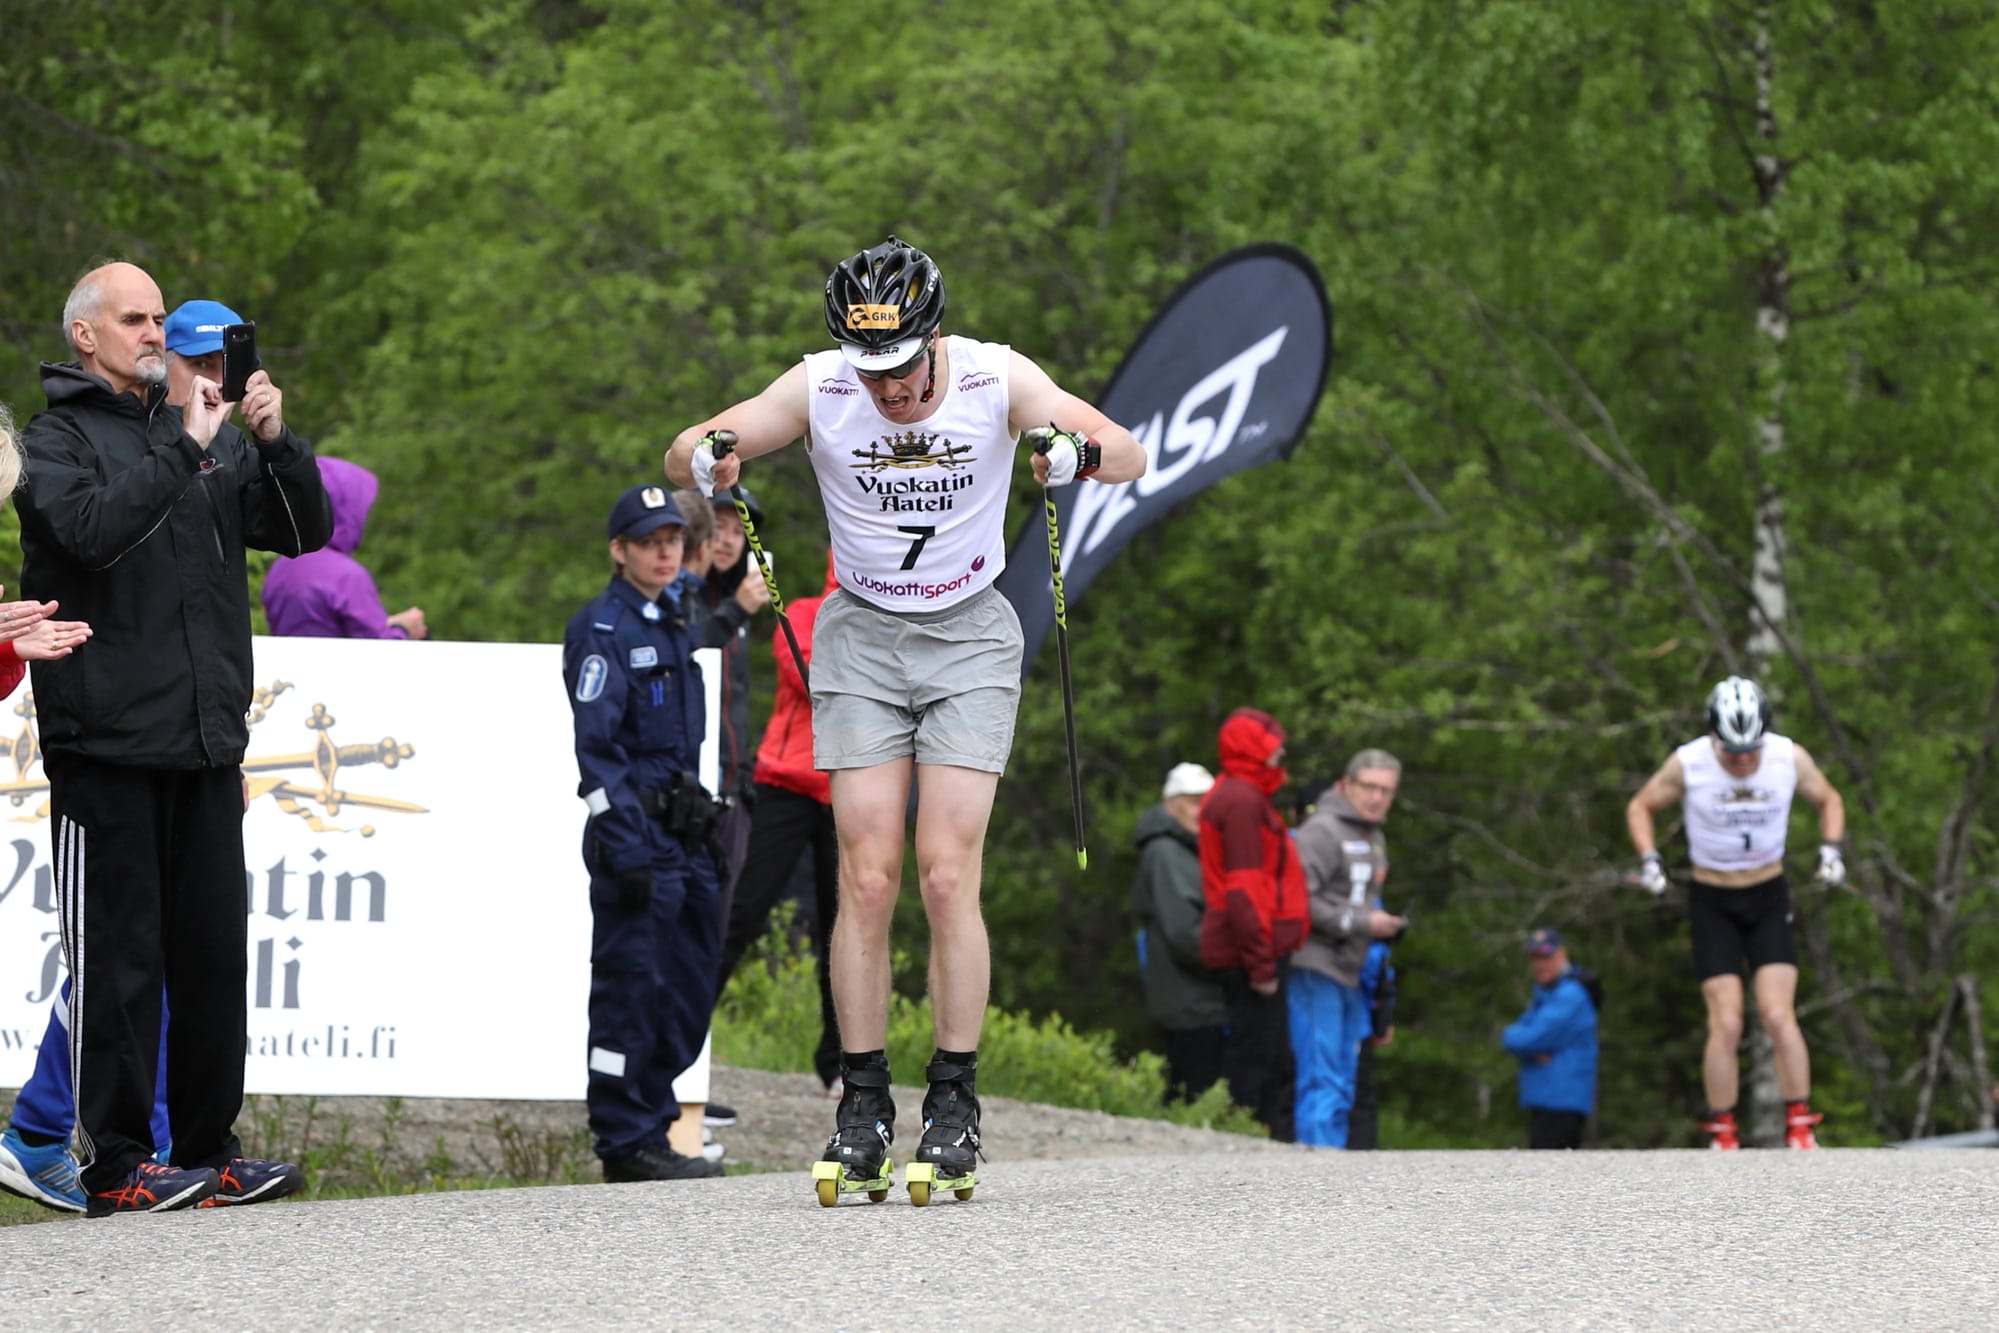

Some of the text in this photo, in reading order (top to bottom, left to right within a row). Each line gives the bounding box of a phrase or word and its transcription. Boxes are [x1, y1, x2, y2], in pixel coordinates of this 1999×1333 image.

[871, 311, 898, 321] GRK
[818, 385, 859, 396] VUOKATTI
[958, 376, 999, 392] VUOKATTI
[855, 473, 974, 495] Vuokatin
[879, 495, 953, 512] Aateli
[896, 525, 936, 571] 7
[1740, 832, 1752, 853] 1
